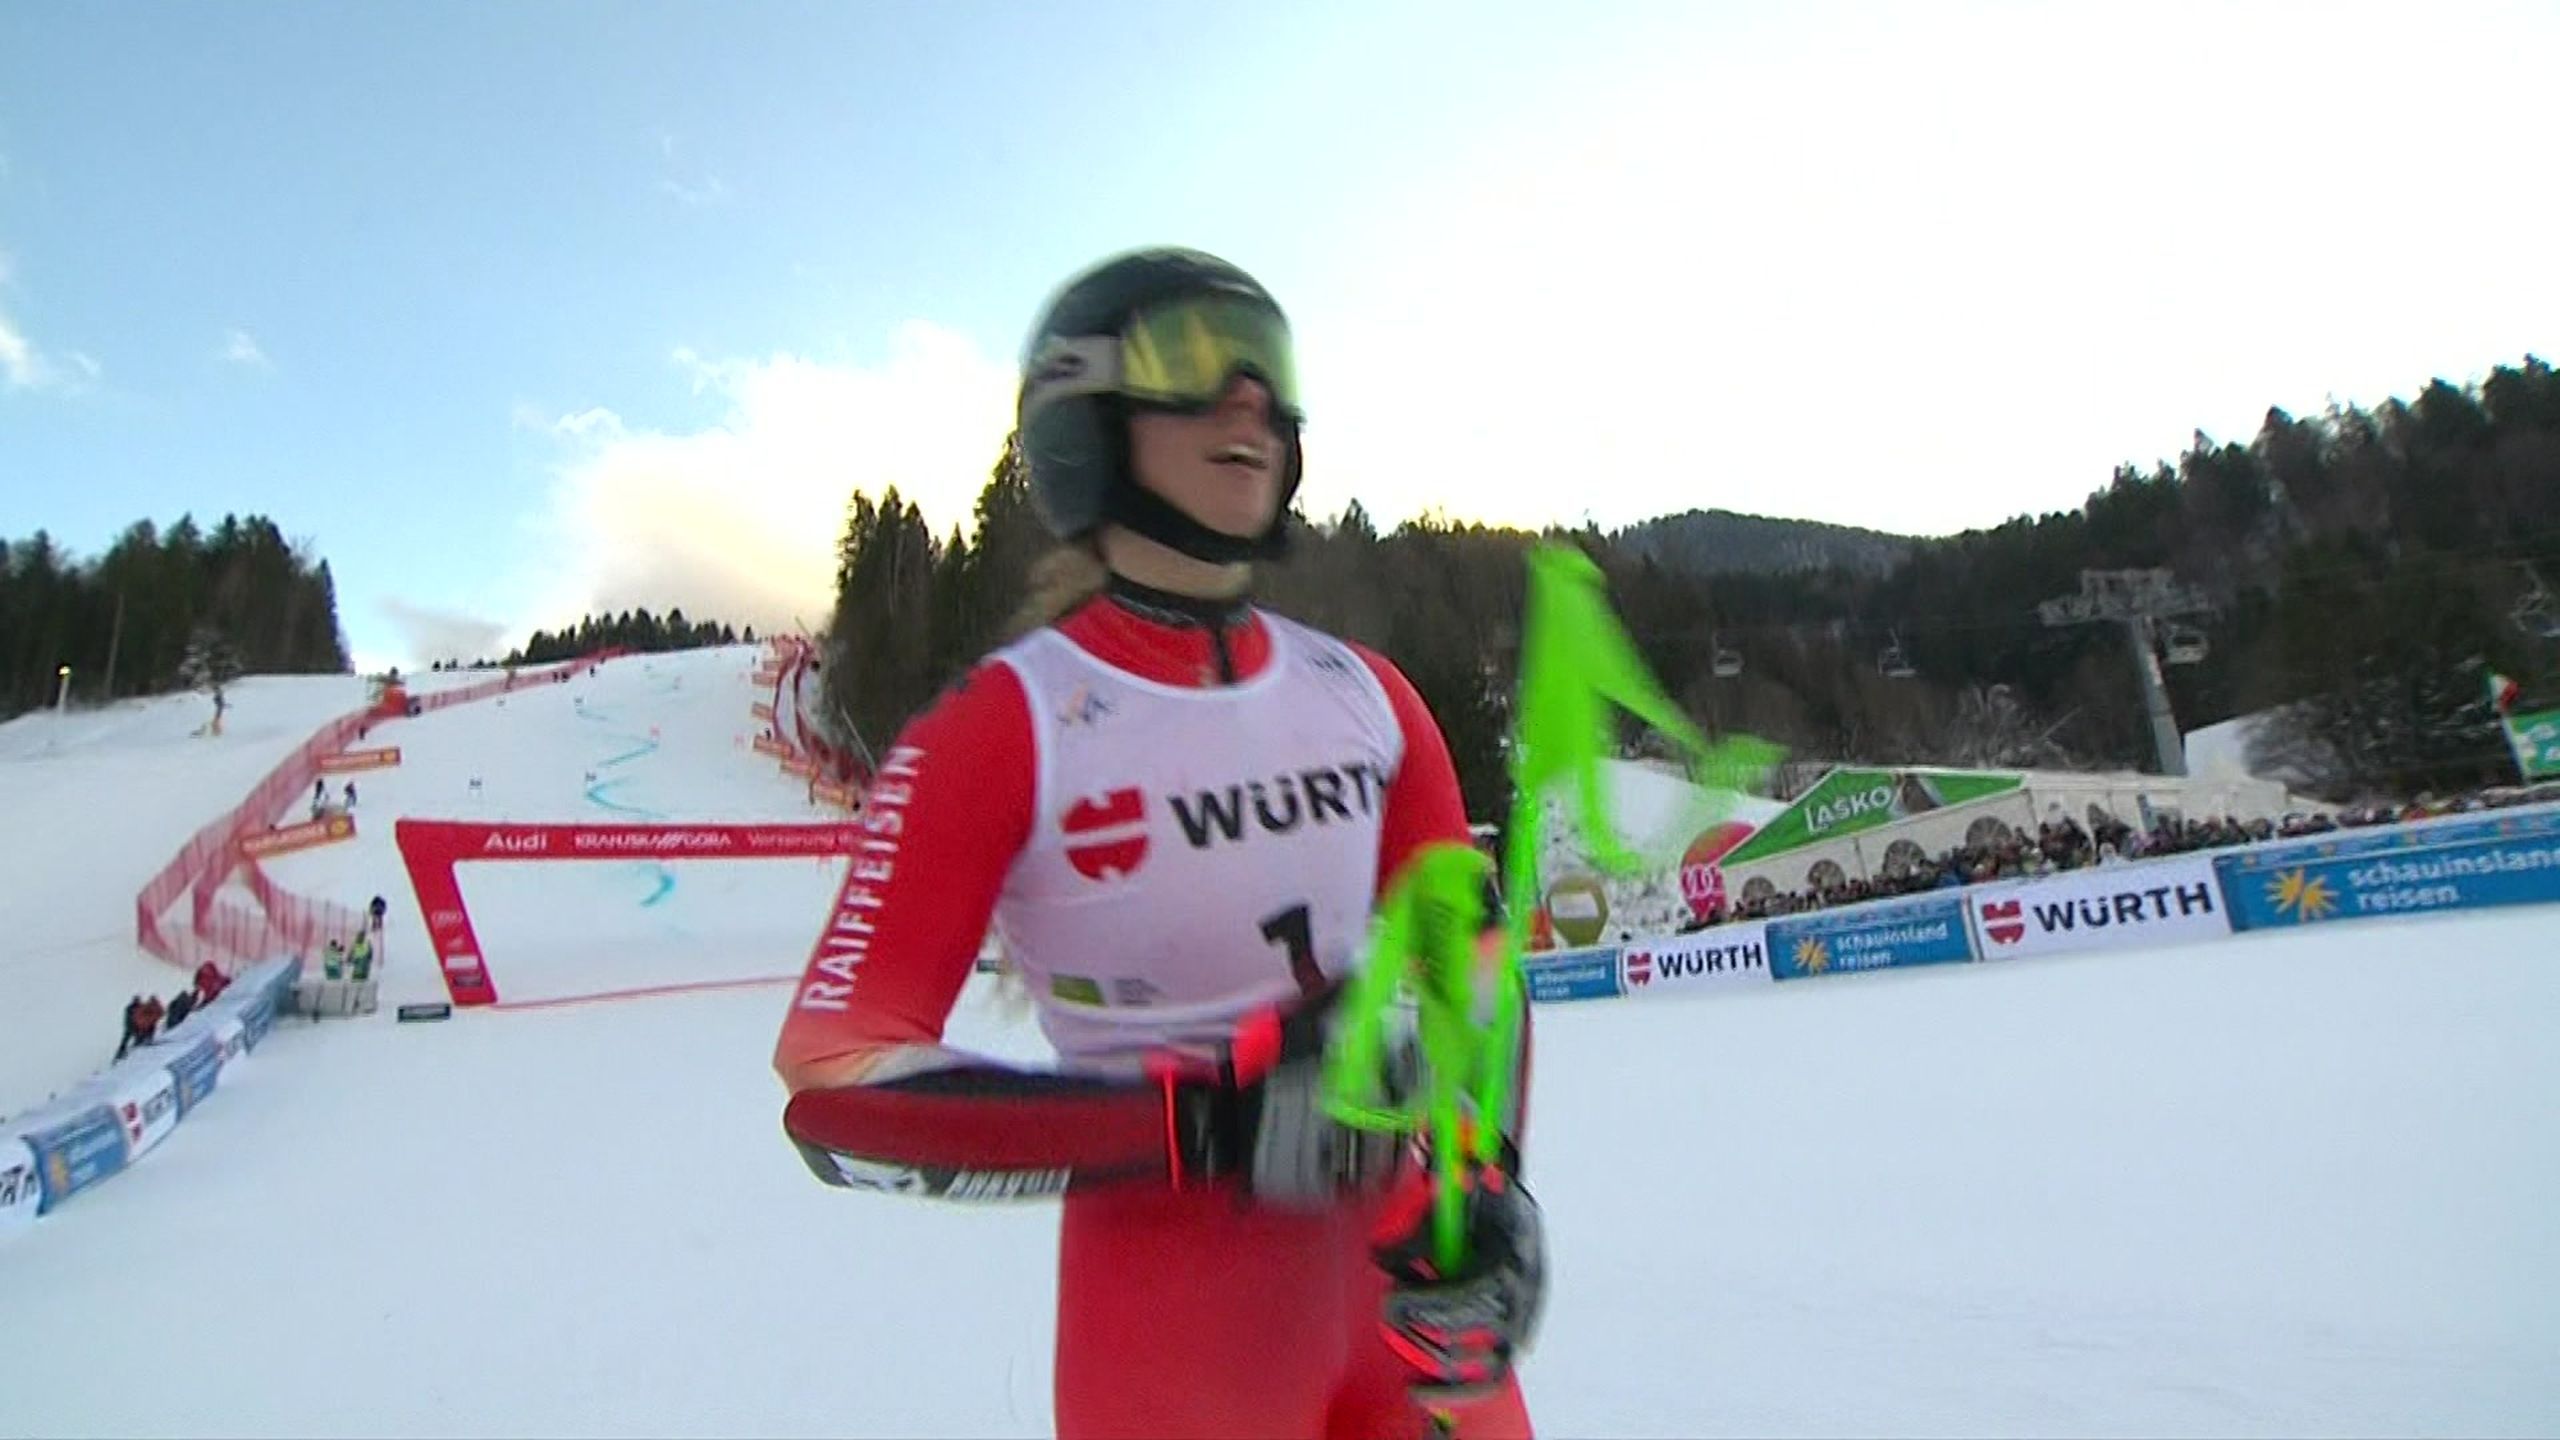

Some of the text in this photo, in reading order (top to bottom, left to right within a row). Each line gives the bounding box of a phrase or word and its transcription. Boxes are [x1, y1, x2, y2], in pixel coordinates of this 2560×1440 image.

[1167, 762, 1386, 849] WÜRT
[484, 831, 548, 850] Audi
[799, 745, 925, 1011] RAIFFEISEN
[2033, 882, 2214, 932] WÜRTH
[2358, 884, 2461, 911] reisen
[1258, 903, 1326, 998] 1
